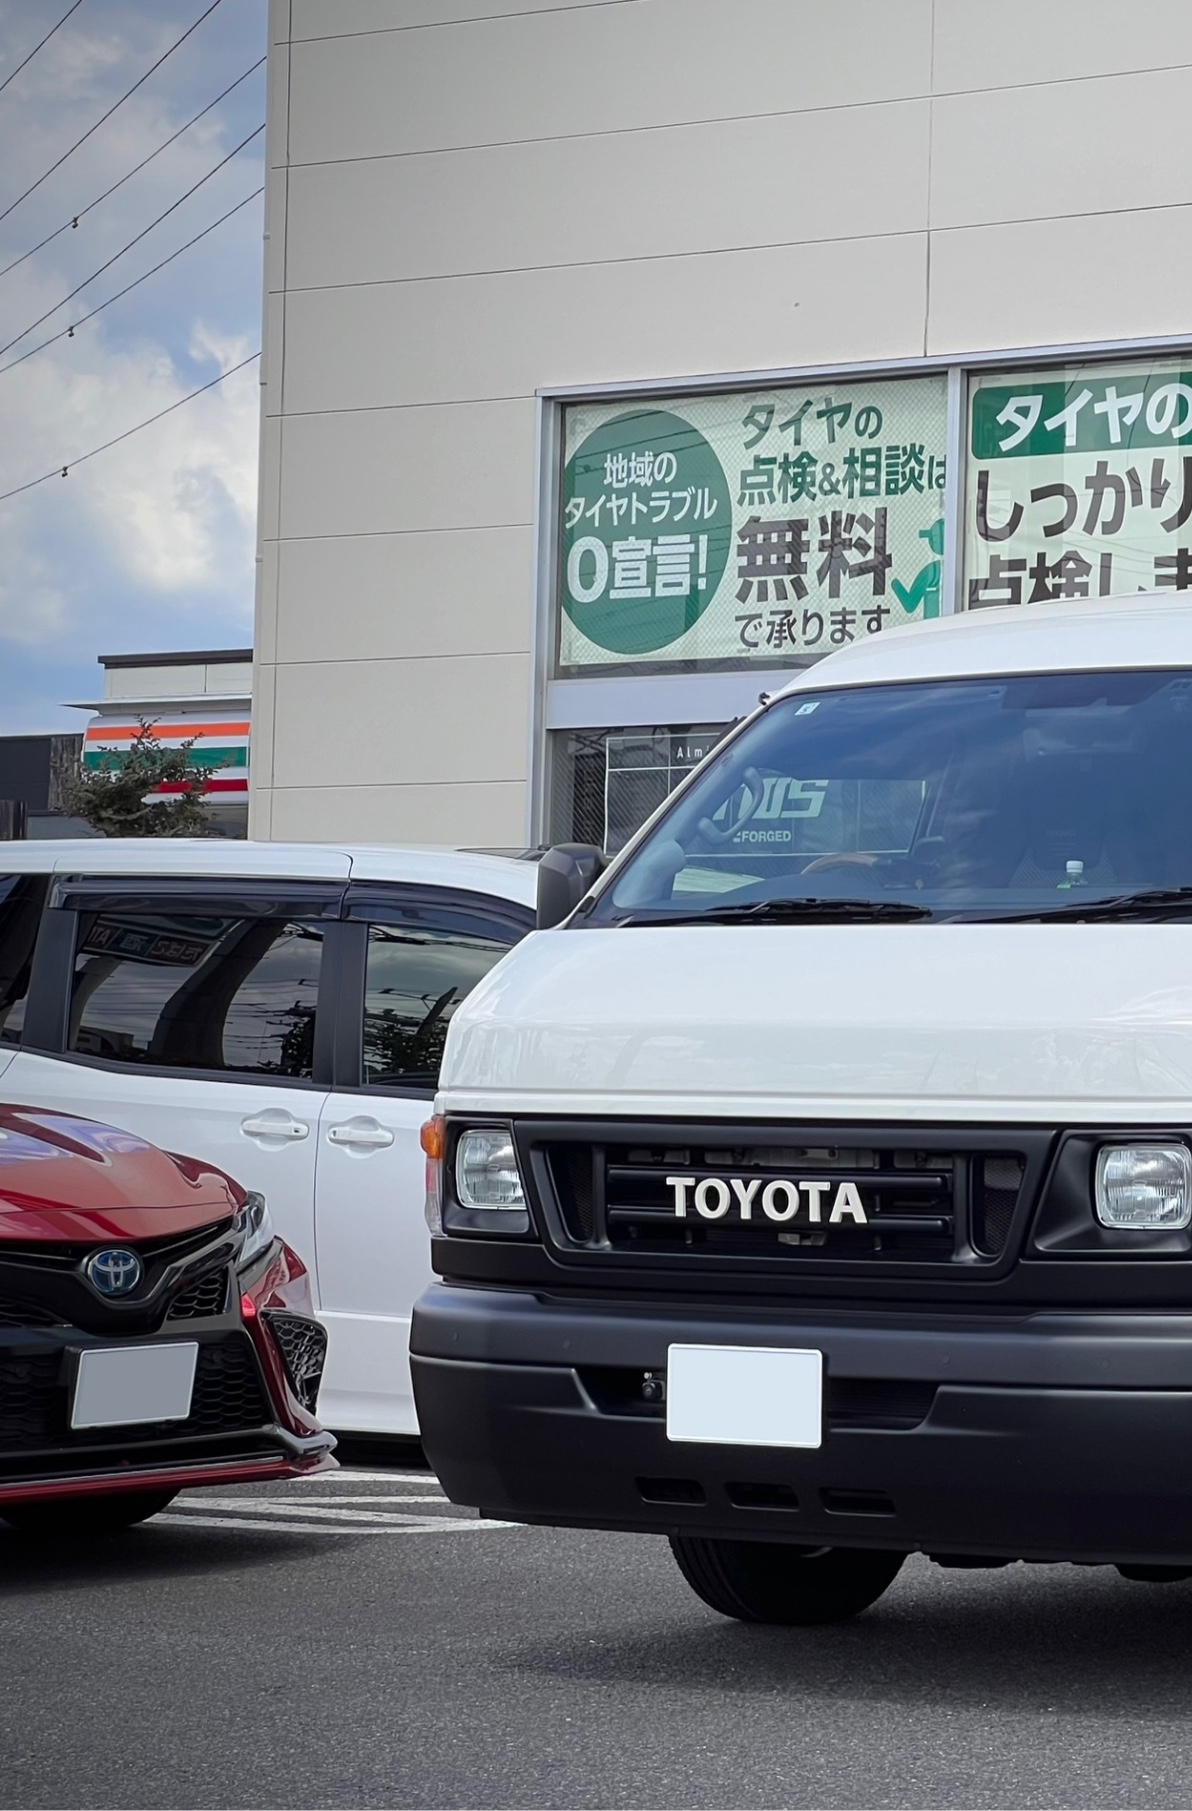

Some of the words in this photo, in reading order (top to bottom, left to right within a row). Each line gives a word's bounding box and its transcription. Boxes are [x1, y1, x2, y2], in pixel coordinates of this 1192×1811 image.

[741, 396, 883, 450] タイヤの
[603, 451, 678, 487] 地域の
[737, 442, 947, 507] 点検&相談は
[564, 486, 718, 530] タイヤトラブル
[566, 533, 708, 604] 0宣言!
[734, 506, 893, 604] 無料
[734, 604, 891, 649] で承ります
[741, 830, 792, 843] FORGED
[665, 1176, 868, 1224] TOYOTA
